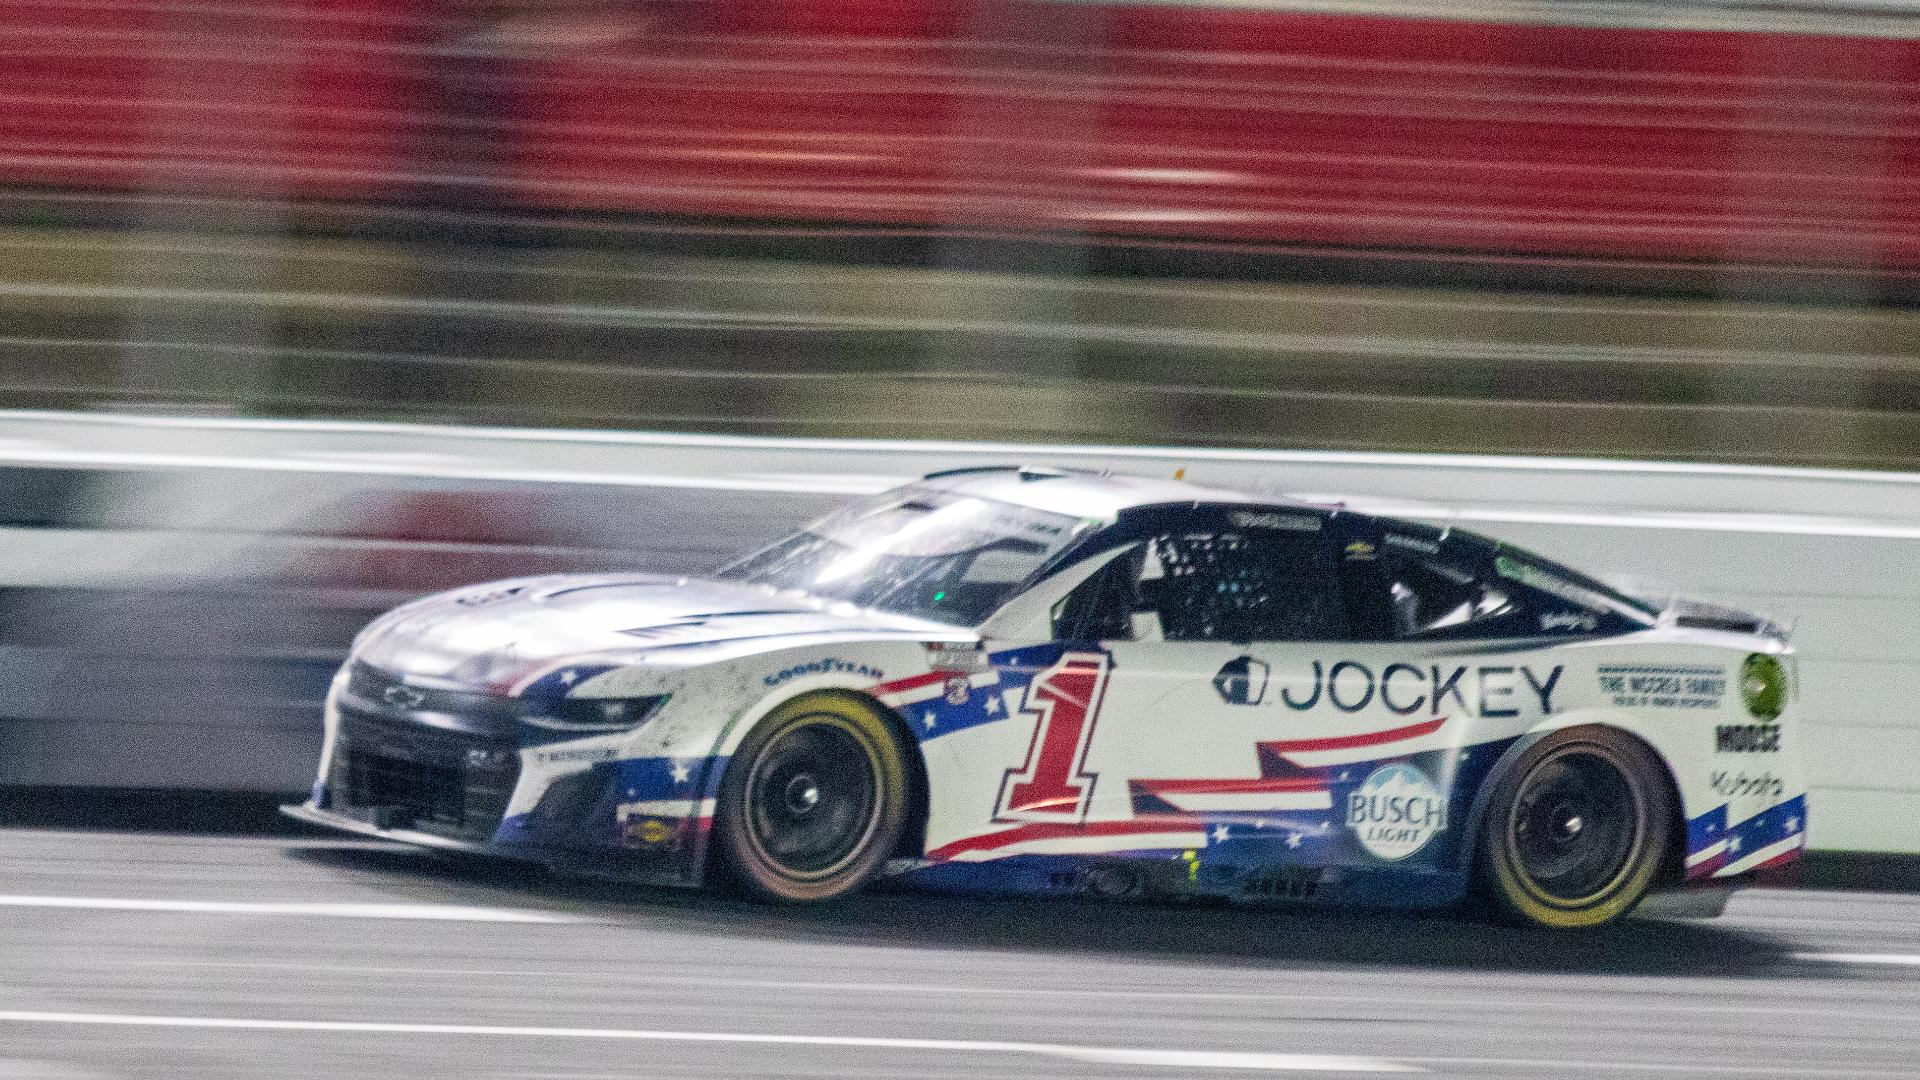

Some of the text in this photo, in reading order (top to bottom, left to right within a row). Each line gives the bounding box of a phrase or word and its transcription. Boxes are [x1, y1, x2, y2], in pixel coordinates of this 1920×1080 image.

[763, 657, 885, 686] GOODYEAR
[1281, 660, 1564, 718] JOCKEY
[991, 651, 1112, 827] 1
[1349, 794, 1446, 829] BUSCH
[1366, 826, 1422, 843] LIGHT
